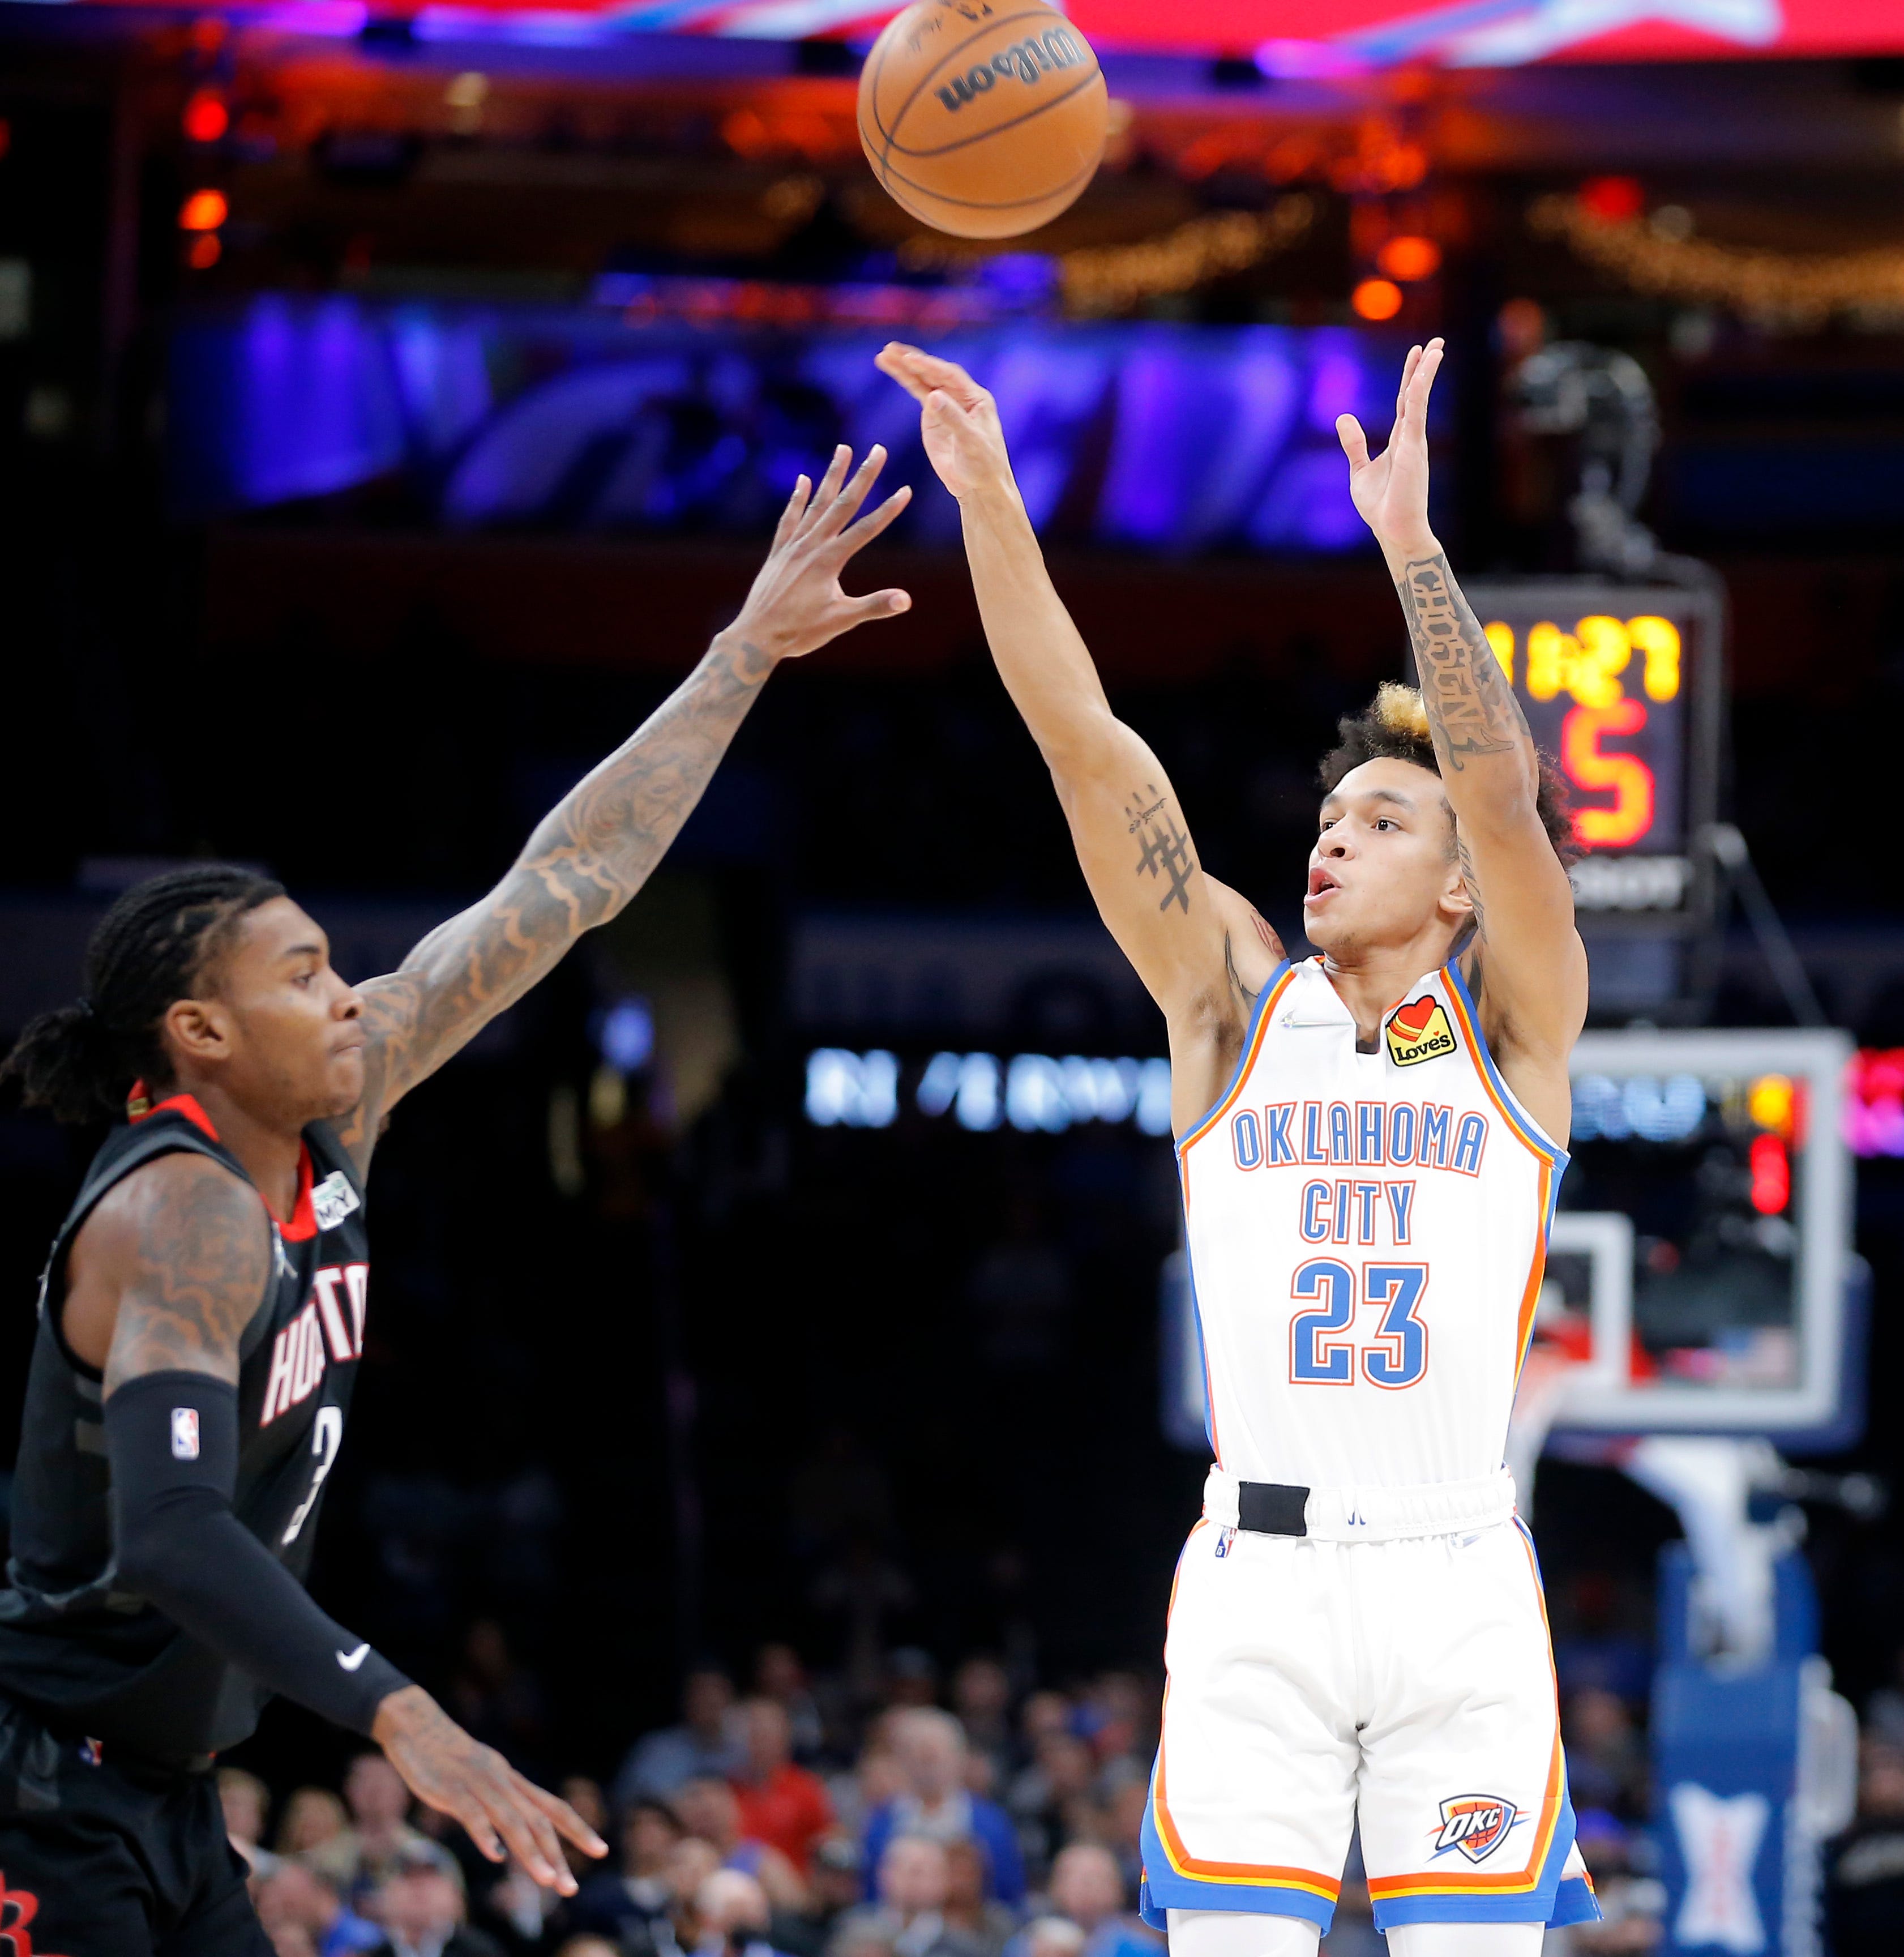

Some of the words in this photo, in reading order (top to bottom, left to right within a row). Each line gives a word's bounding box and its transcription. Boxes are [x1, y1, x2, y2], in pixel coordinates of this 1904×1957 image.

[934, 27, 1086, 111] Wilson
[1561, 698, 1654, 847] 5
[1230, 1100, 1489, 1178] OKLAHOMA
[1299, 1179, 1416, 1245] CITY
[1289, 1257, 1429, 1390] 23
[1435, 1807, 1503, 1851] OKC
